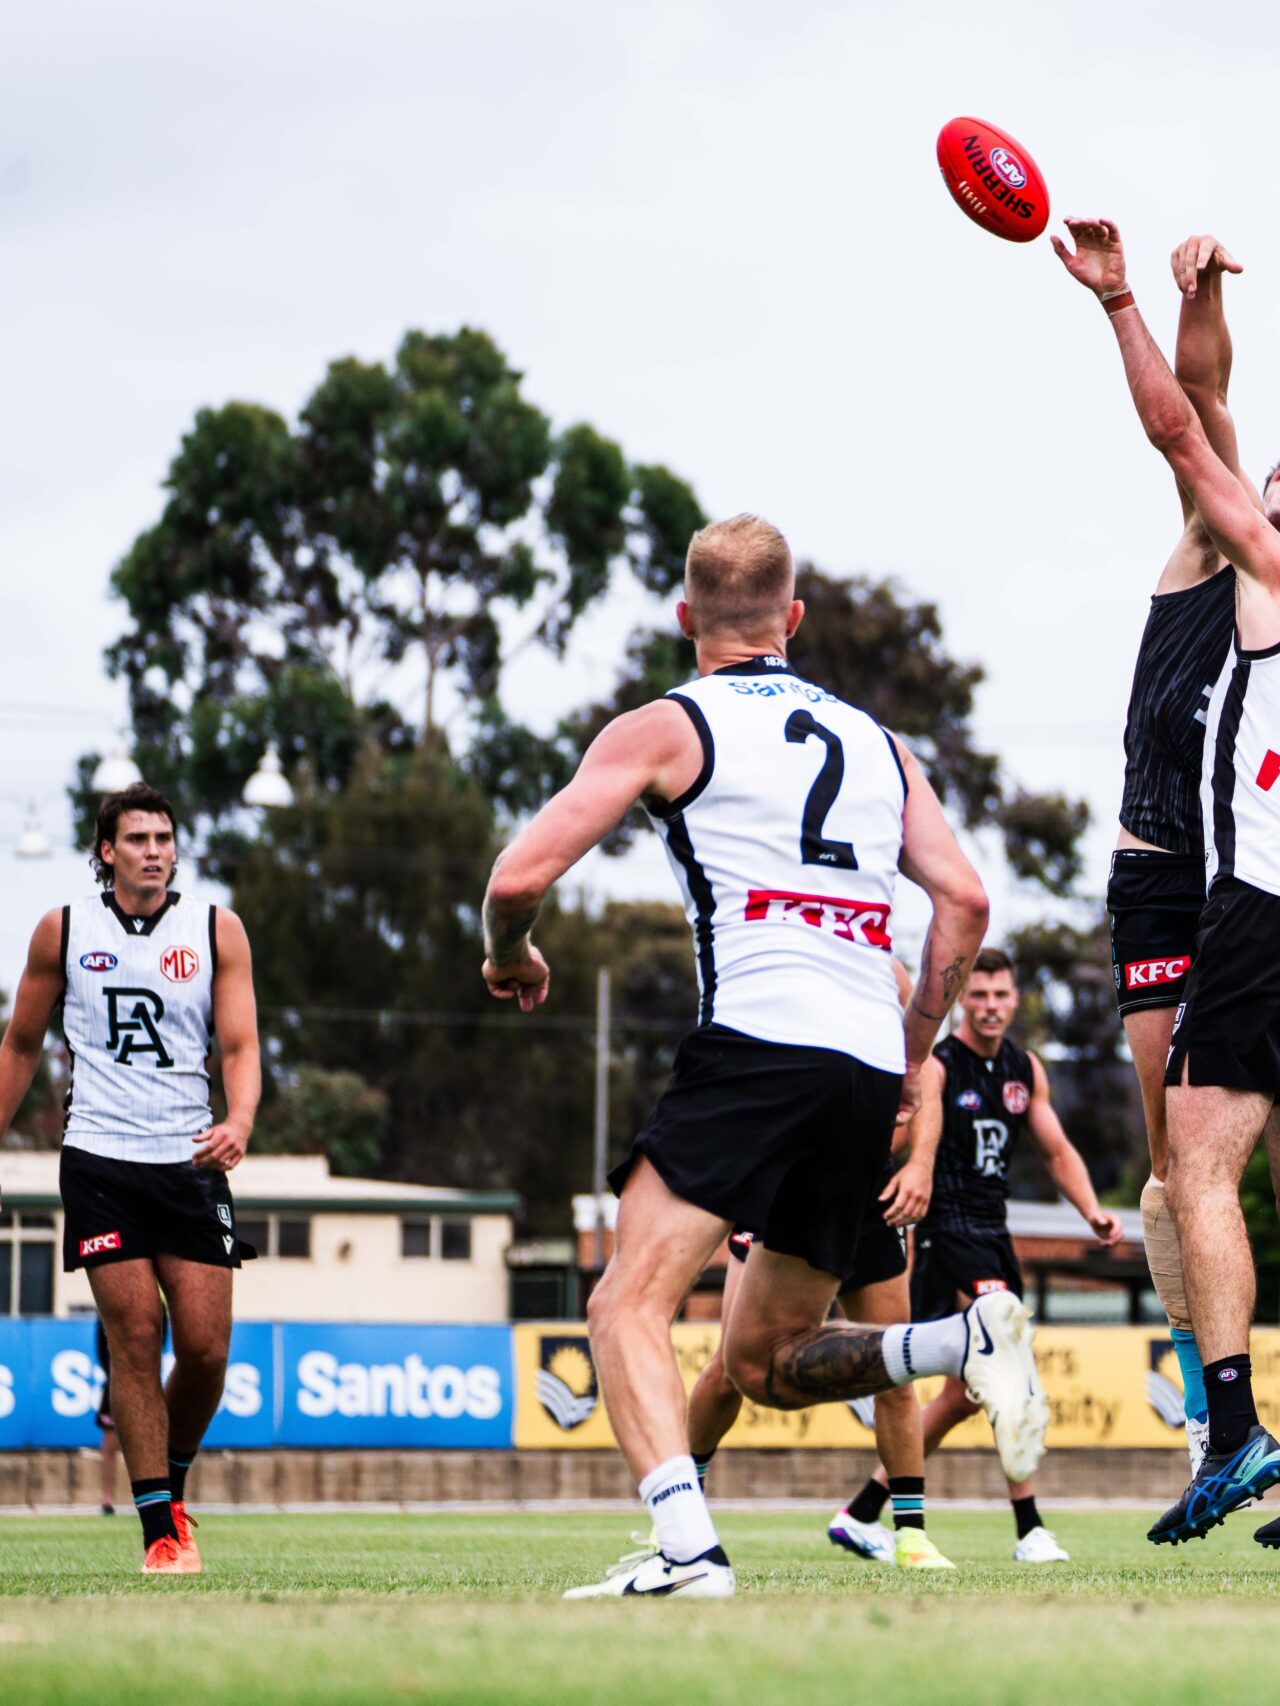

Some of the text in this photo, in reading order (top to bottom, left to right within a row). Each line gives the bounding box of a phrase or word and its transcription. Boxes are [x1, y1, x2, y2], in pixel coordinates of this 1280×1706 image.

[962, 134, 1036, 219] SHERRIN
[995, 149, 1026, 184] AFL
[784, 708, 859, 871] 2
[763, 898, 882, 949] KFC
[82, 955, 116, 968] AFL
[163, 949, 196, 979] MG
[1128, 959, 1185, 987] KFC
[82, 1233, 117, 1255] KFC
[297, 1350, 502, 1419] Santos
